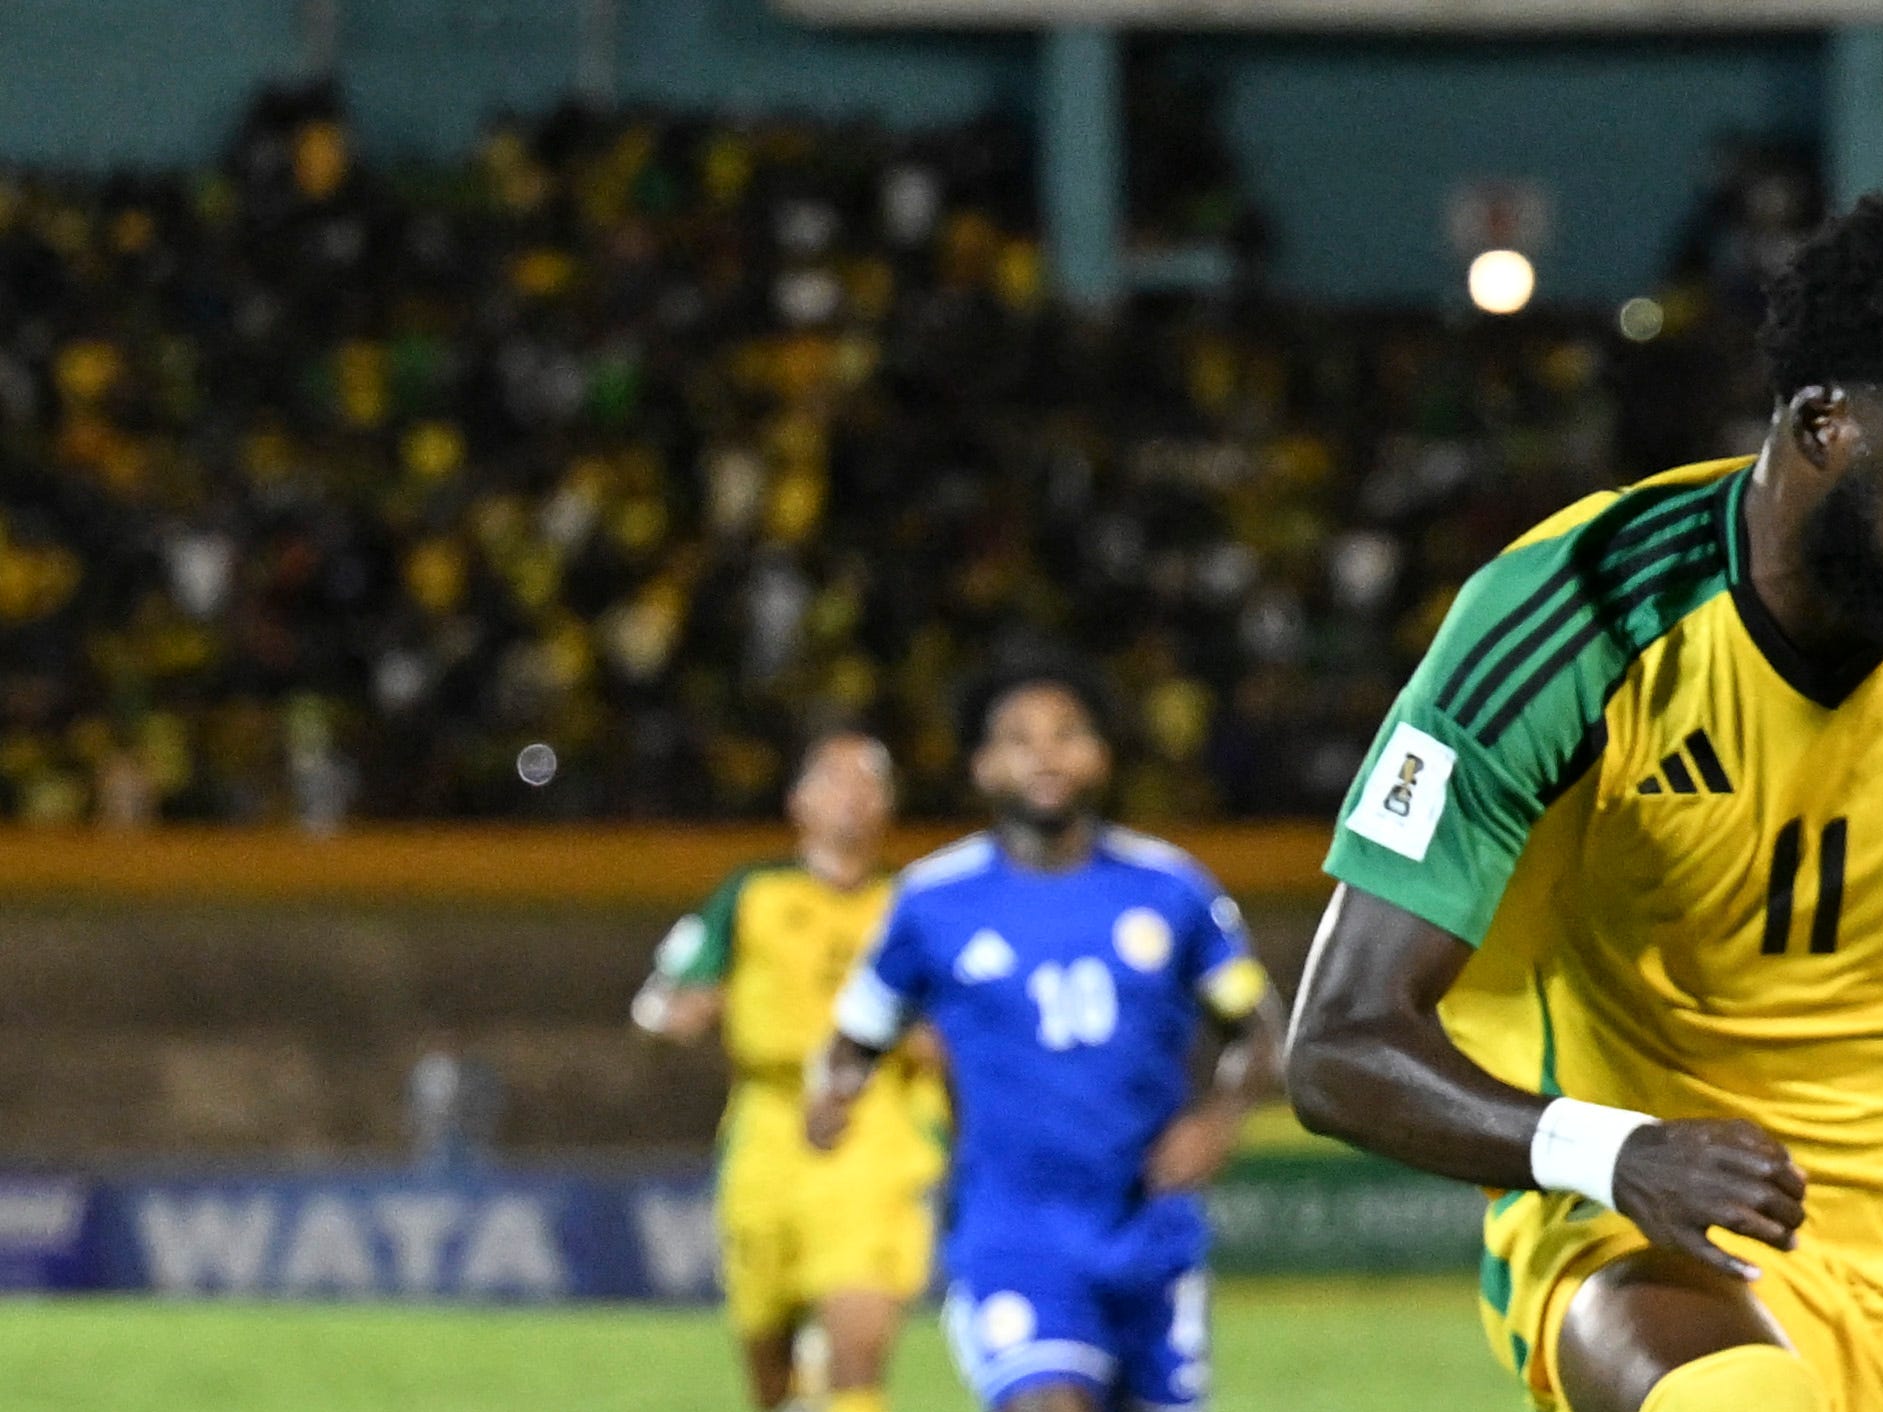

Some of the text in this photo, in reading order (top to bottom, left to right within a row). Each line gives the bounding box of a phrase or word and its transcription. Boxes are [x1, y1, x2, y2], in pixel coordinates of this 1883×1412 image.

[1761, 816, 1848, 954] 11
[1024, 957, 1118, 1050] 10
[138, 1190, 568, 1291] WATA
